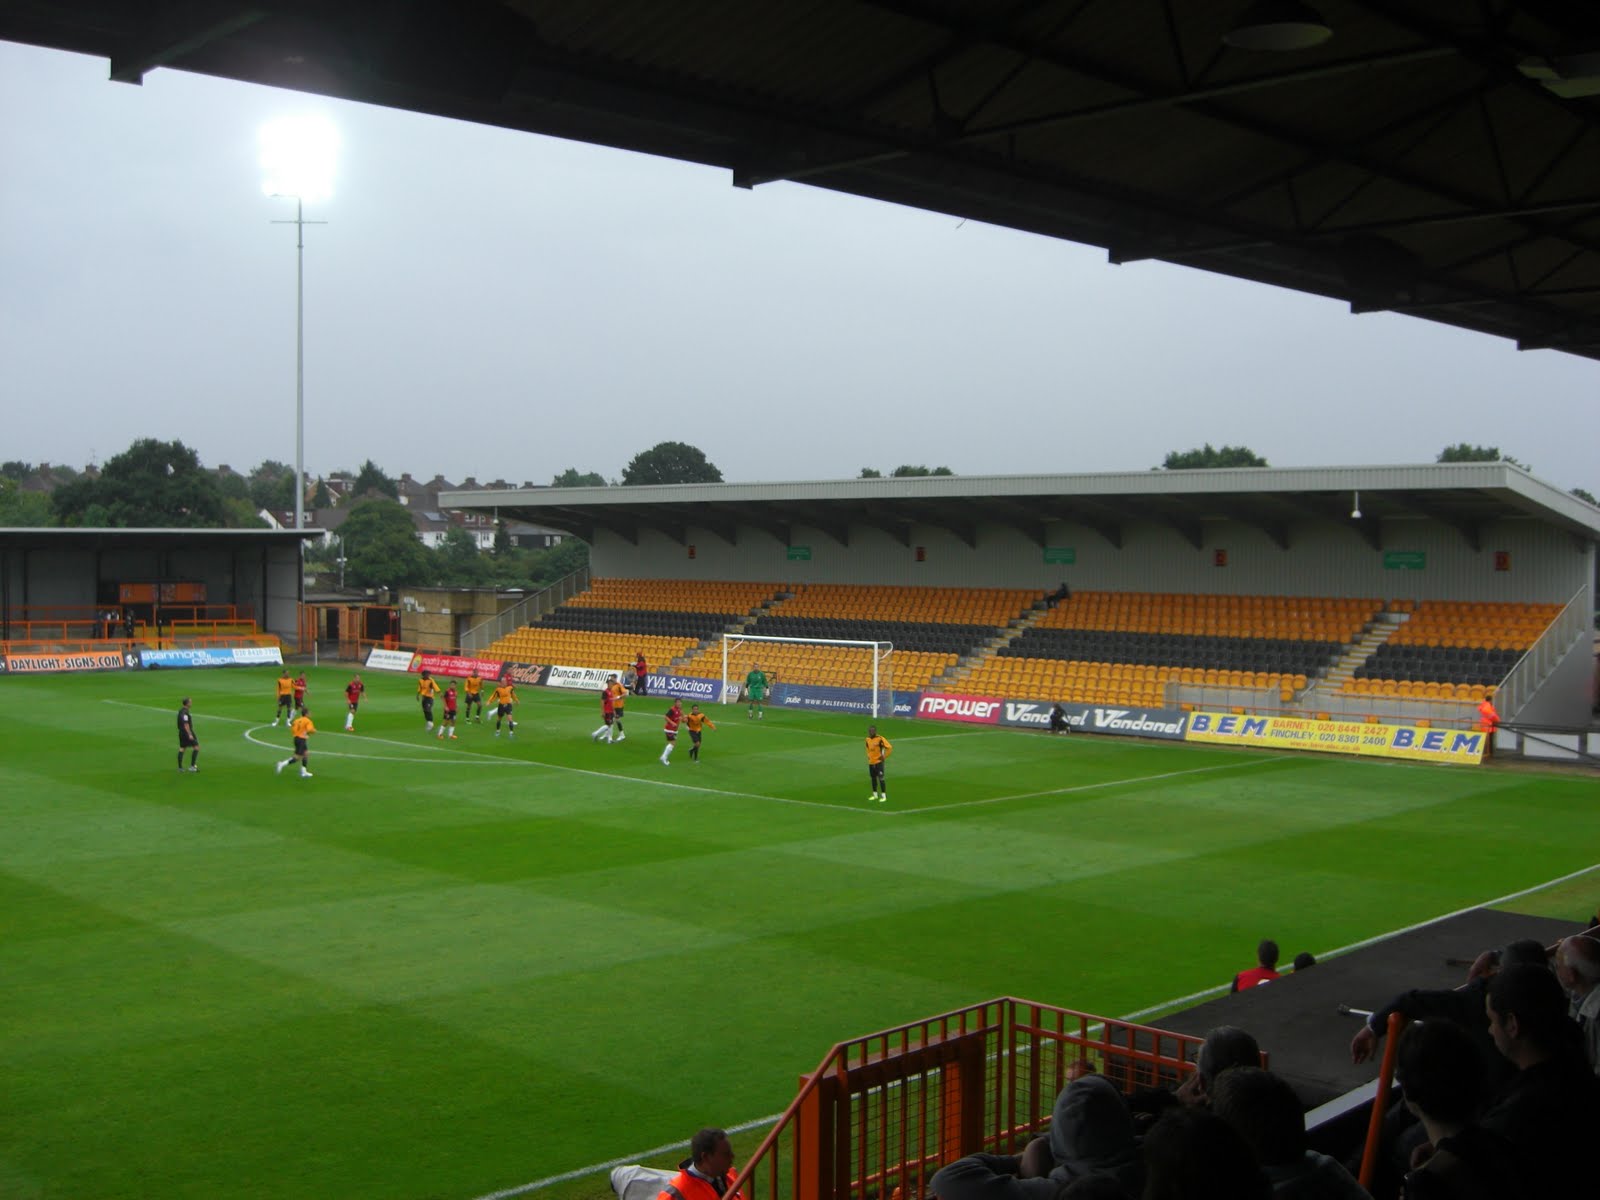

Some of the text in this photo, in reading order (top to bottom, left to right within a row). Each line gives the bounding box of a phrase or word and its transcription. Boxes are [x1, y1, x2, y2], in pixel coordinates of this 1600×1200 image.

[141, 650, 206, 660] stanmore
[192, 654, 235, 665] college
[11, 656, 120, 670] DAYLIGHT-SIGNS.COM
[552, 667, 613, 684] Duncan Phillip
[646, 676, 666, 689] YVA
[668, 678, 713, 693] Solicitors
[785, 696, 801, 704] pulse
[893, 704, 911, 712] pulse
[1095, 709, 1185, 734] Vandanel
[1317, 722, 1335, 732] 020
[1337, 724, 1360, 734] 8441
[1364, 726, 1389, 736] 2427
[1319, 733, 1336, 742] 020
[1337, 734, 1360, 744] 8361
